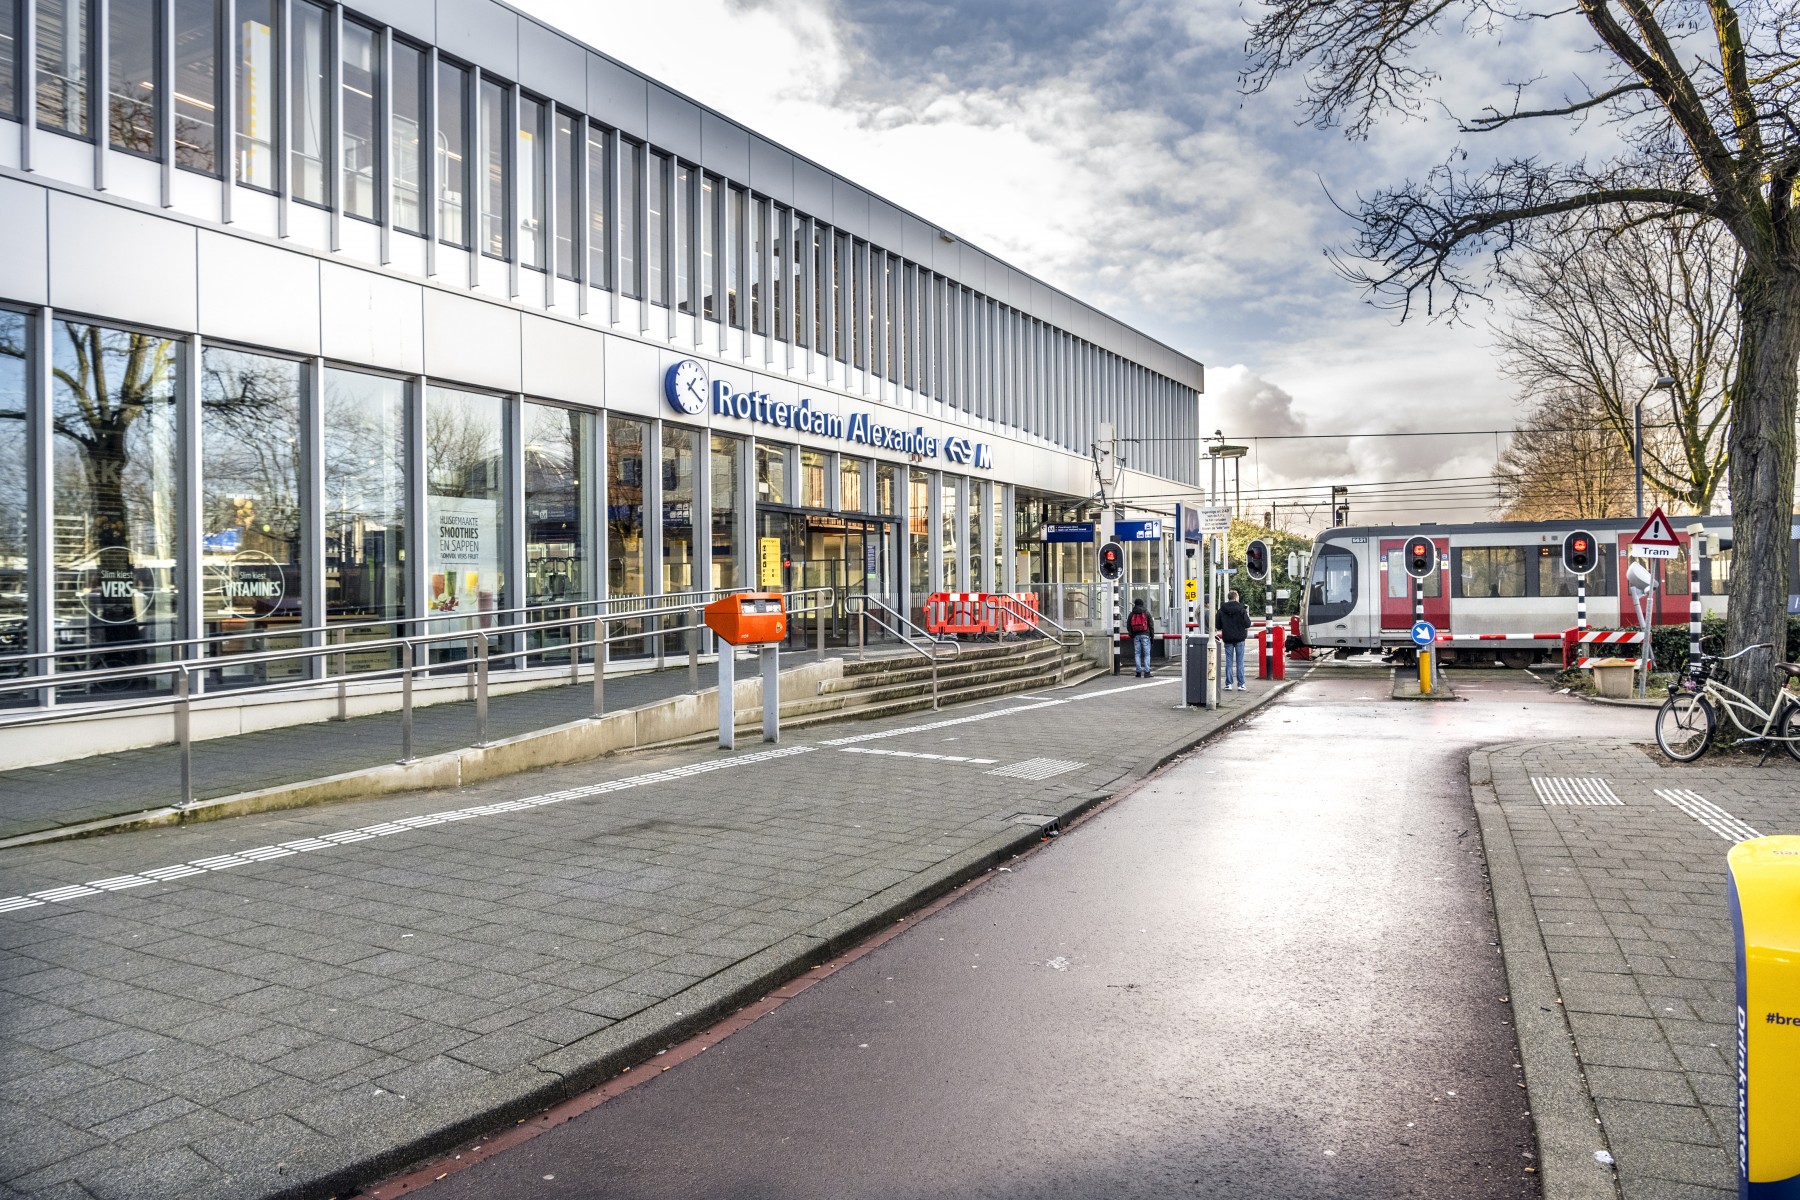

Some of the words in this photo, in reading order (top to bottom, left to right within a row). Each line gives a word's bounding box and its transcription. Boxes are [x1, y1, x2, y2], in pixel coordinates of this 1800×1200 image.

[713, 380, 844, 438] Rotterdam
[847, 413, 941, 457] Alexander
[440, 515, 479, 526] HUISGEMAAKTE
[440, 526, 479, 539] SMOOTHIES
[440, 540, 450, 551] EN
[451, 540, 479, 552] SAPPEN
[1643, 547, 1669, 555] Tram
[101, 570, 115, 578] Slim
[116, 570, 134, 579] kiest
[240, 571, 251, 580] Slim
[252, 571, 267, 580] kiest
[101, 581, 134, 597] VERS
[226, 581, 281, 597] VITAMINES
[1766, 1012, 1800, 1027] #bre
[1737, 1005, 1747, 1178] Drinkwater
